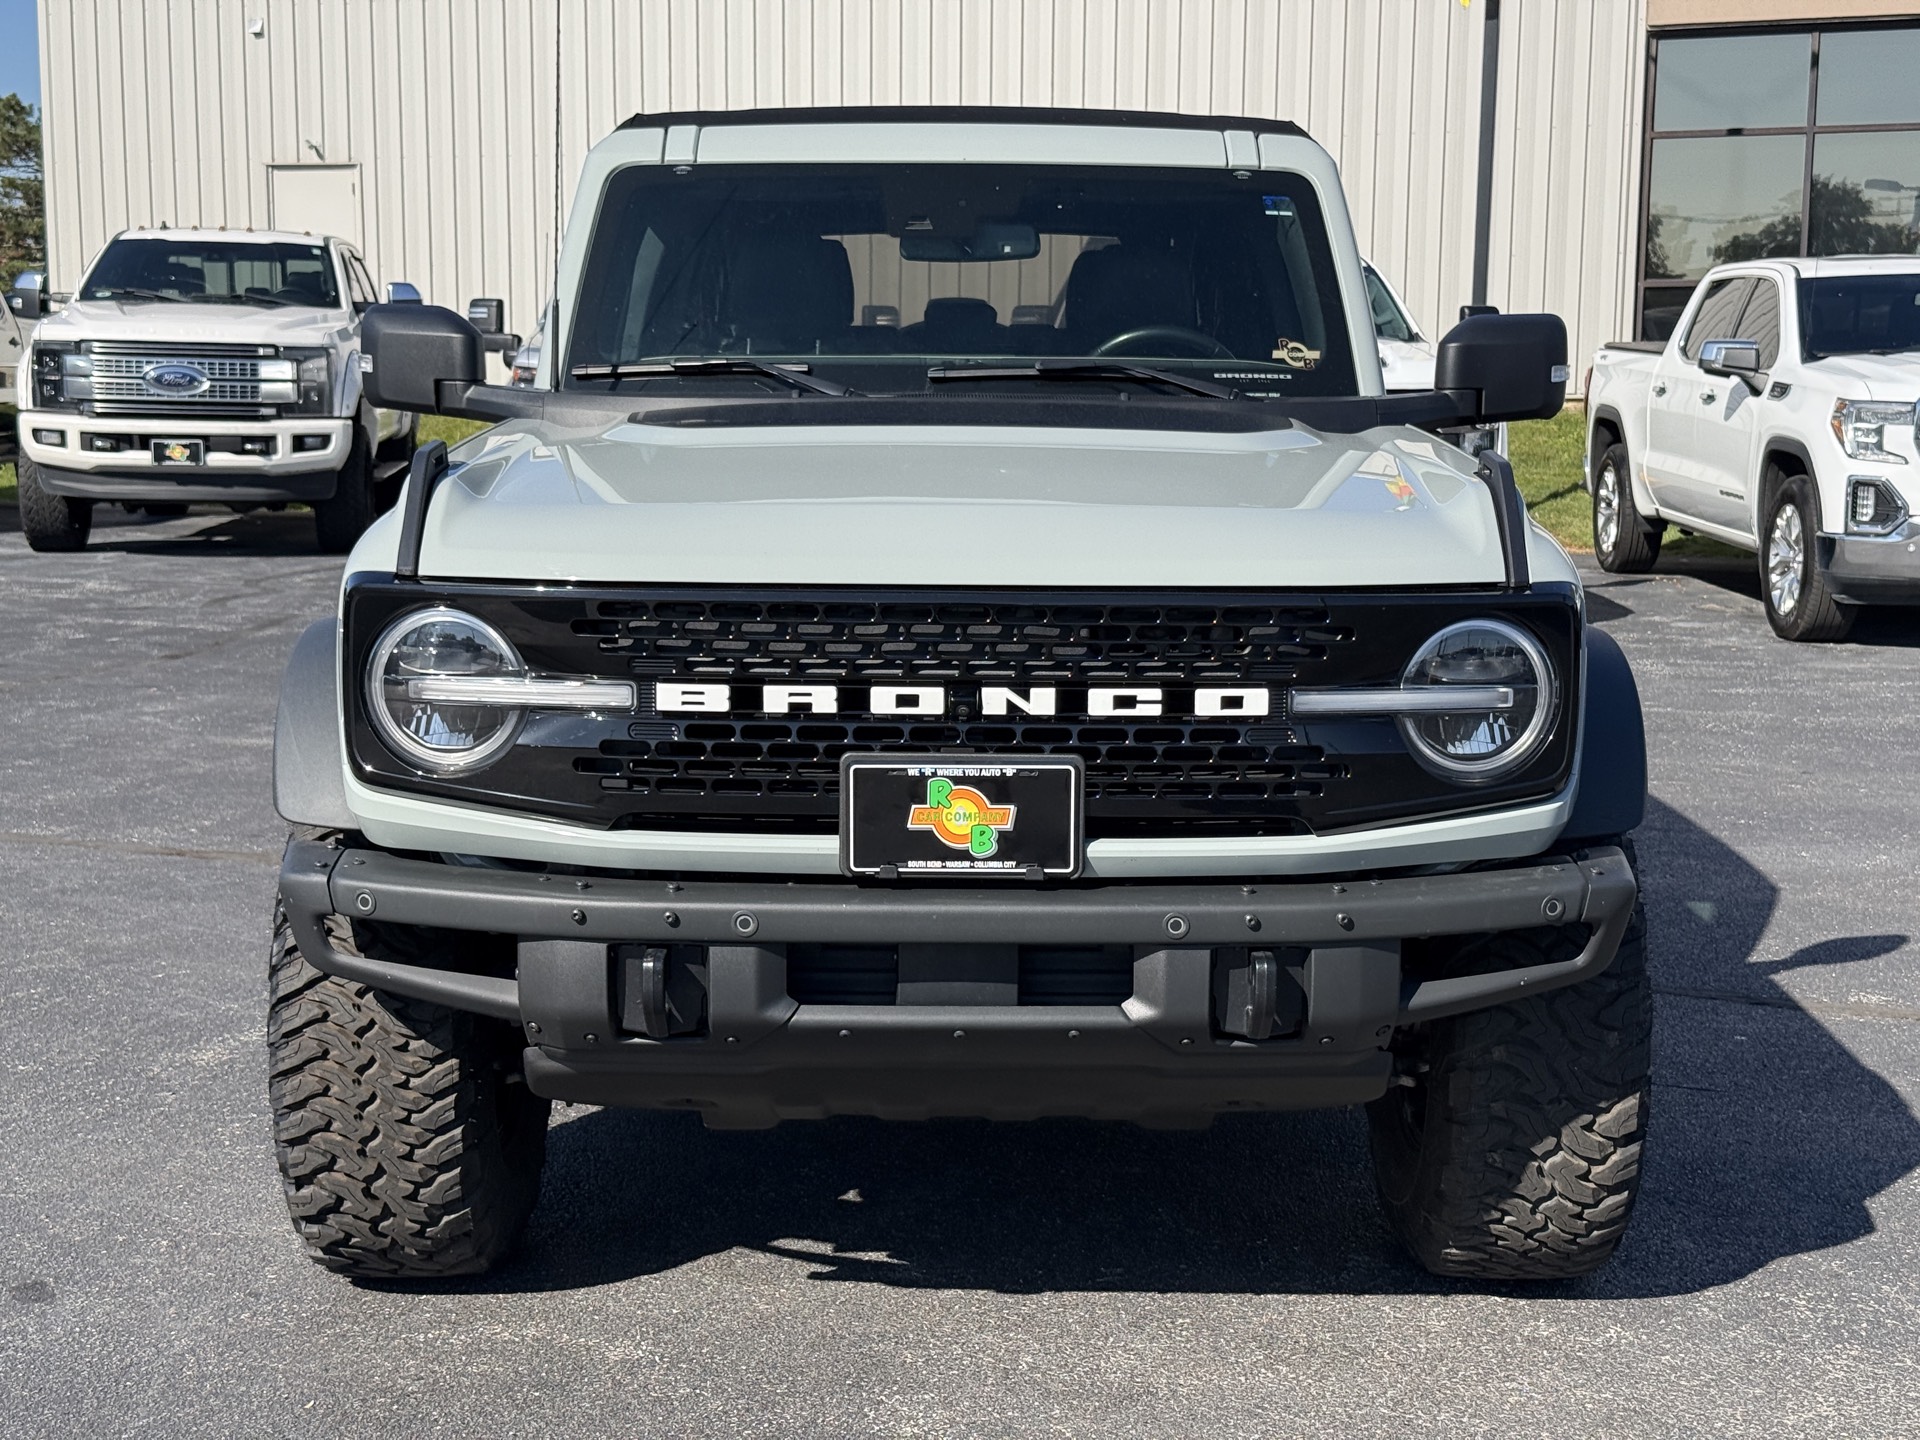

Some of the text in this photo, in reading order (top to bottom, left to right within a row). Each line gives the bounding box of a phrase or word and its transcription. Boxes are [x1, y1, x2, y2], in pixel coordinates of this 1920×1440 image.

[162, 373, 190, 385] Ford
[656, 683, 1270, 716] BRONCO
[907, 768, 920, 776] WE
[936, 768, 963, 776] WHERE
[964, 768, 980, 776] YOU
[980, 768, 1001, 776] AUTO
[929, 779, 953, 809] R
[916, 811, 1006, 822] CAR COMPANY
[971, 824, 994, 854] B
[907, 860, 1017, 868] SOUTH BEND WARSAW COLUMBIA CITY
